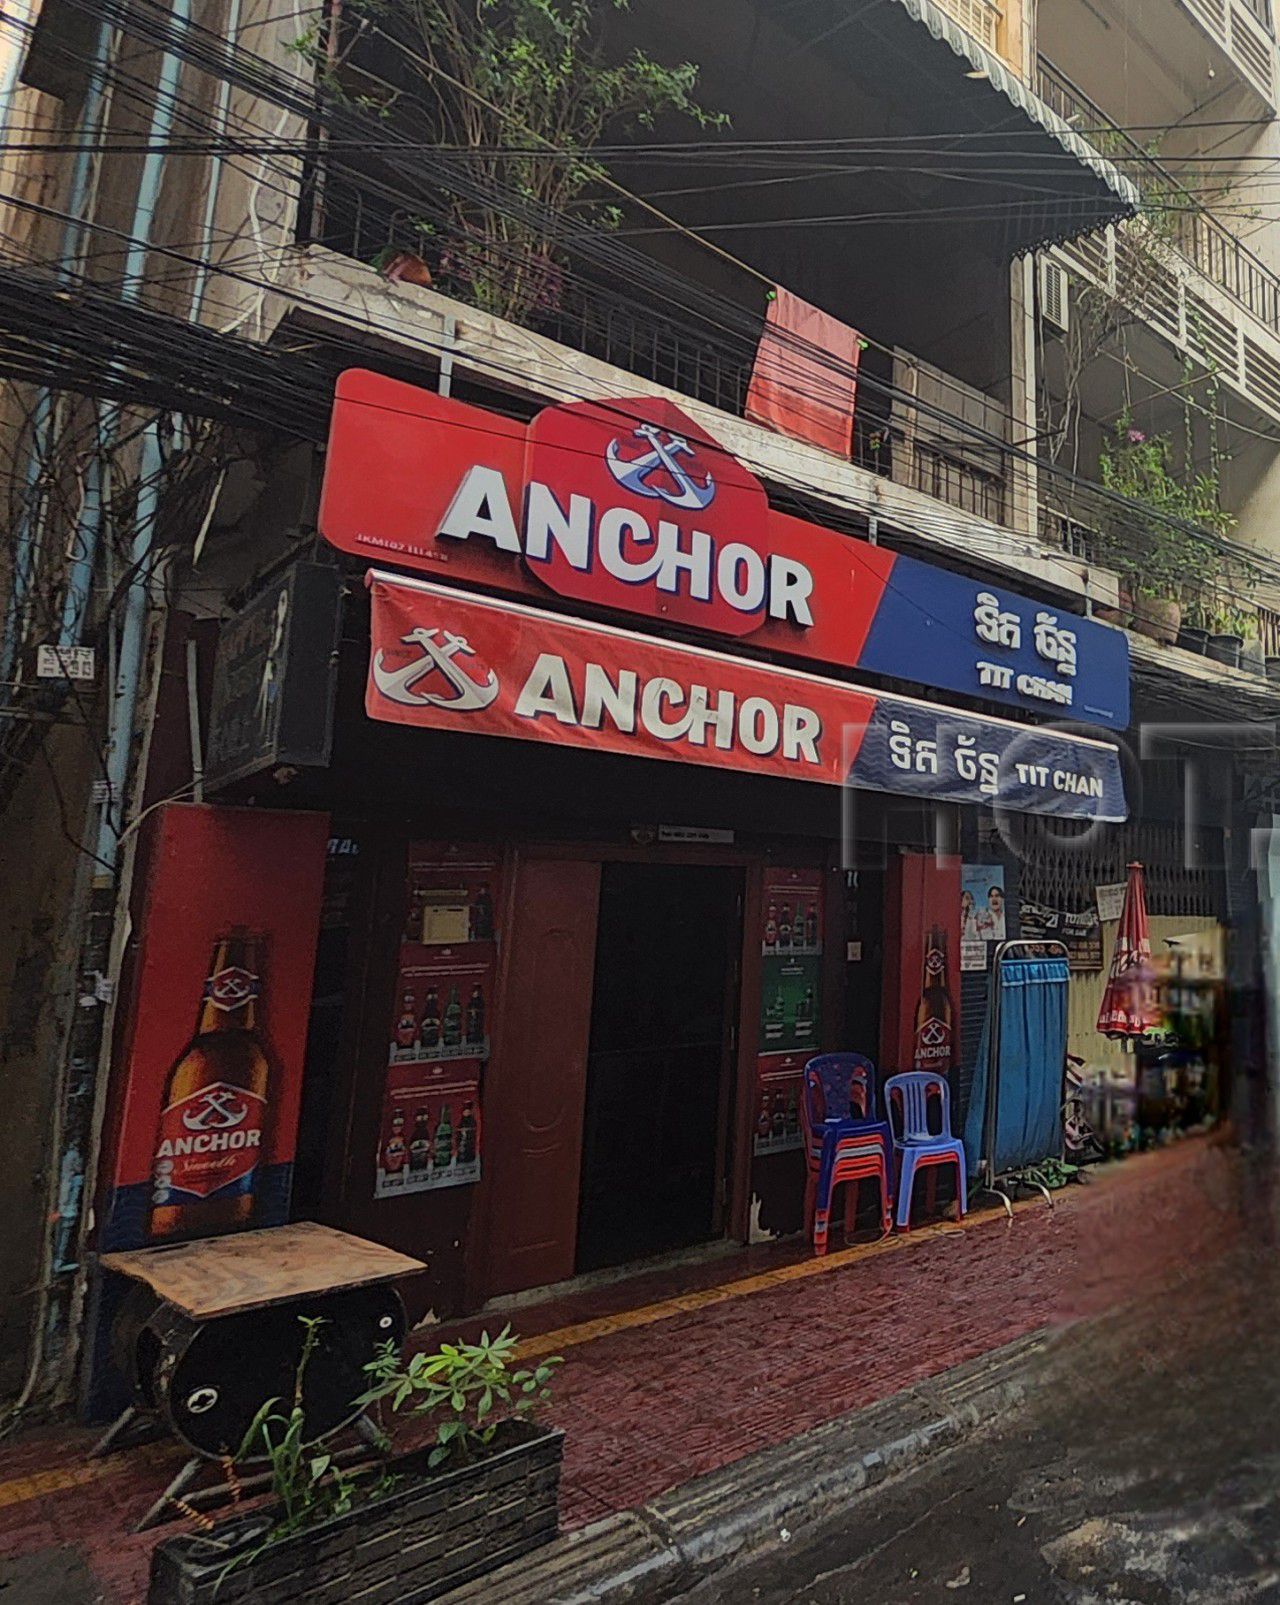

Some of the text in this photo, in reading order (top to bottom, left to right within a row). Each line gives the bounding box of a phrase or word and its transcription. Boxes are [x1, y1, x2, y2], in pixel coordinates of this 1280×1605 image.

[434, 465, 814, 627] ANCHOR
[976, 661, 1073, 705] TIT CHAN
[513, 653, 821, 764] ANCHOR
[1015, 763, 1104, 799] TIT CHAN
[914, 1045, 951, 1060] ANCHOR
[155, 1129, 262, 1158] ANCHOR
